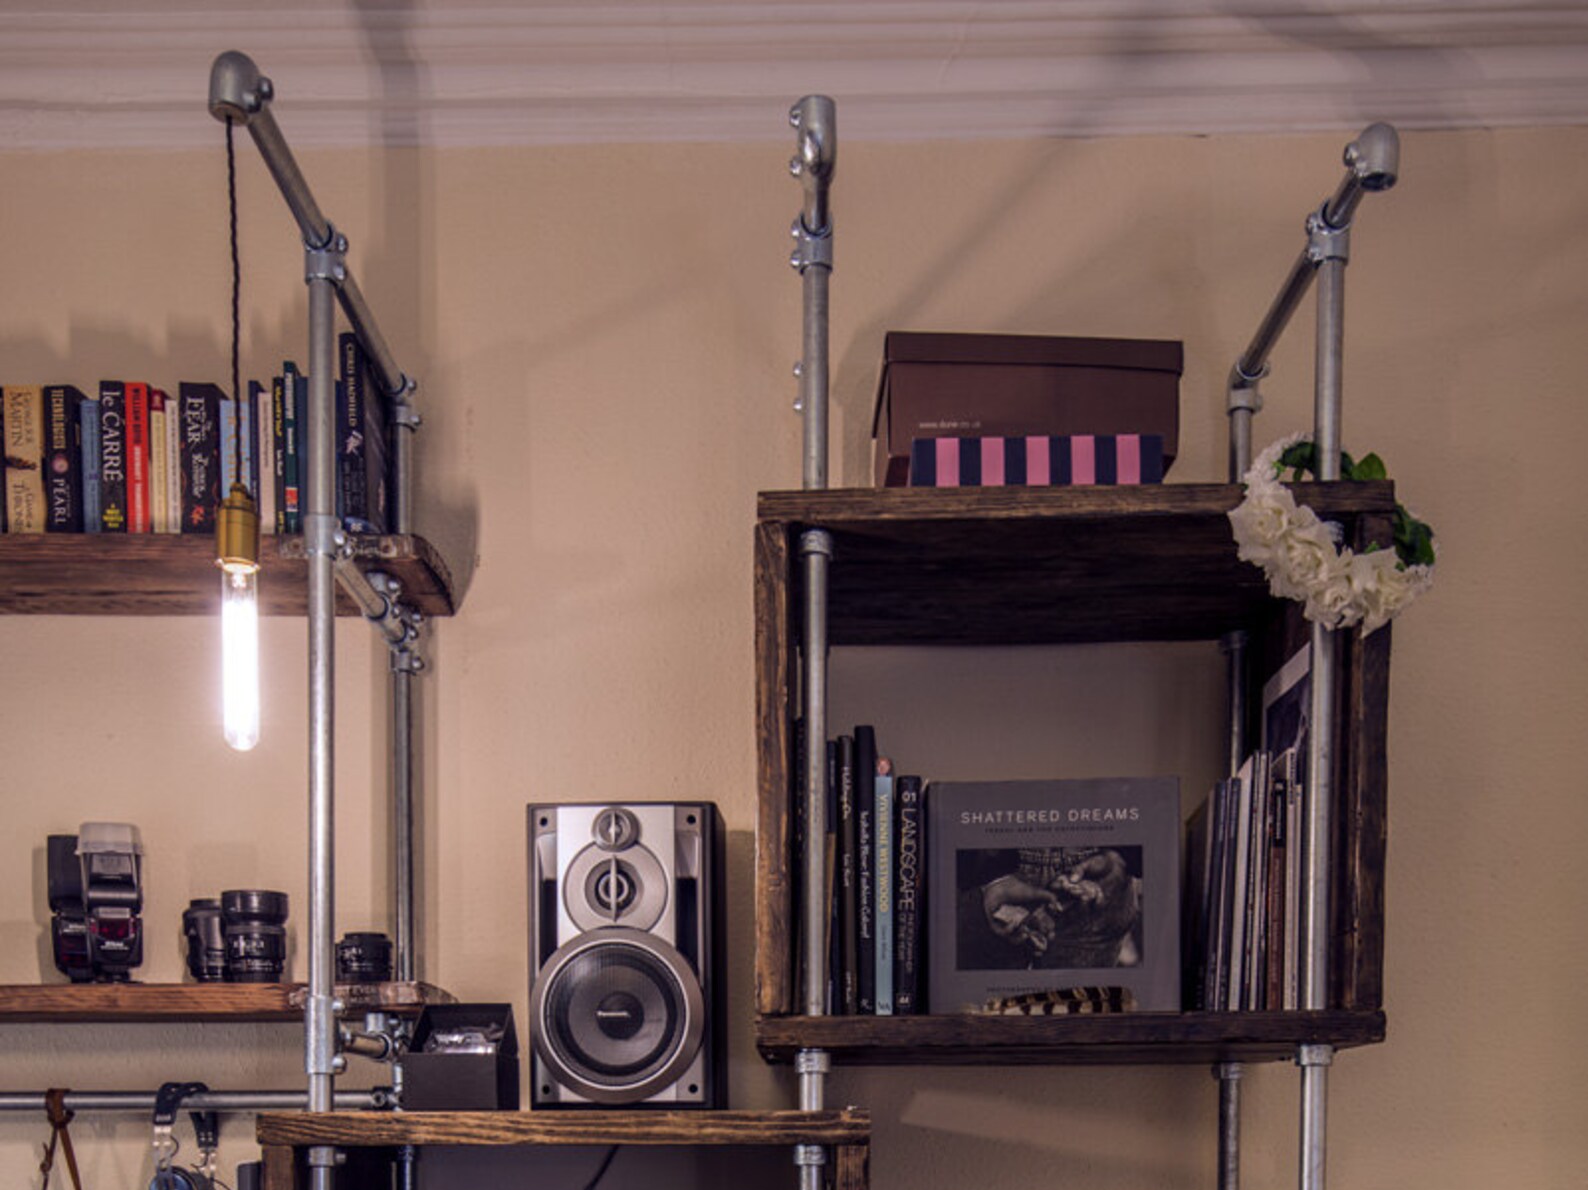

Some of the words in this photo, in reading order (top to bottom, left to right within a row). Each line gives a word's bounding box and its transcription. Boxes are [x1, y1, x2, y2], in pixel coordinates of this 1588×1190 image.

[960, 810, 1060, 824] SHATTERED
[1067, 807, 1140, 822] DREAMS
[879, 847, 889, 913] WESTWOOD
[899, 807, 917, 911] LANDSCAPE
